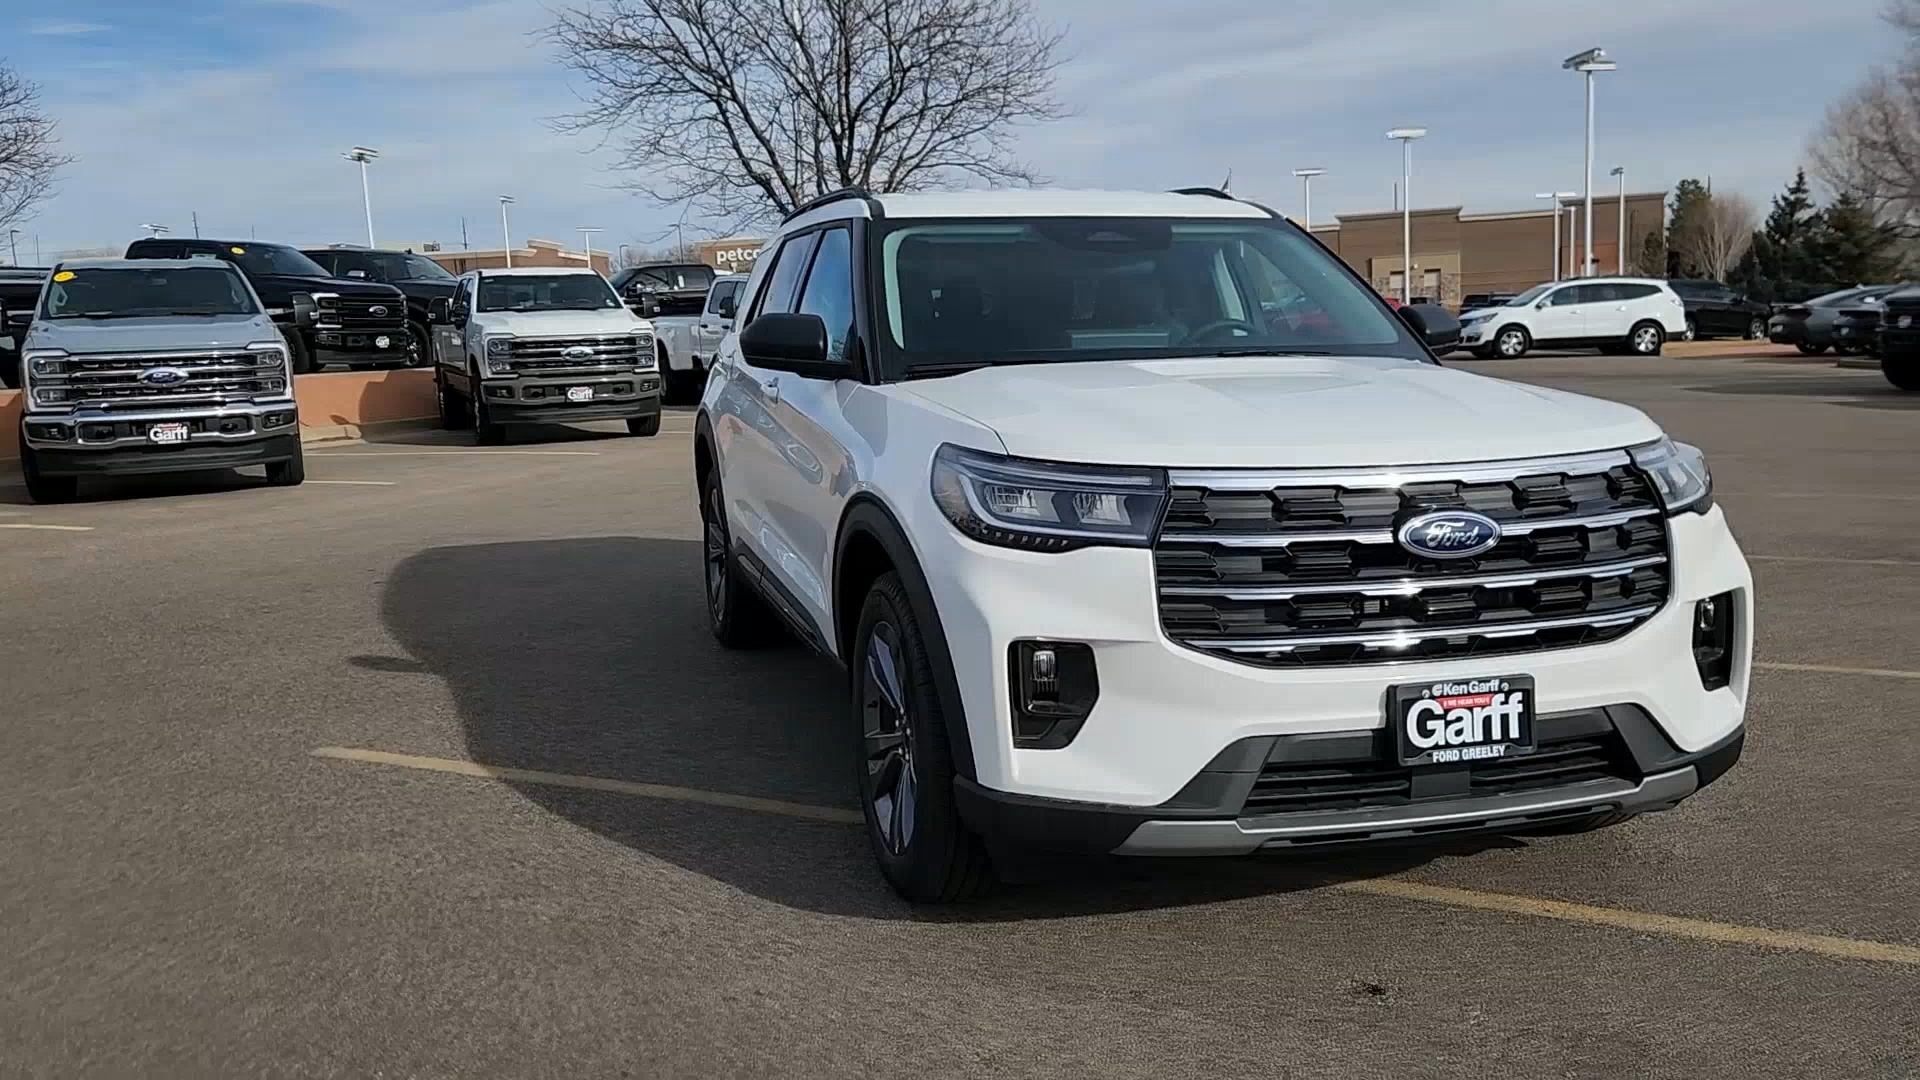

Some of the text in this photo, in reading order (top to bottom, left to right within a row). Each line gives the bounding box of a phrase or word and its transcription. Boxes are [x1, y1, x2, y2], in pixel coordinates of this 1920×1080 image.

[149, 426, 188, 441] Garff
[1425, 521, 1479, 548] Ford
[1443, 679, 1500, 696] Ken Garff
[1406, 692, 1524, 749] Garff
[1432, 745, 1506, 763] FORD GREELEY
